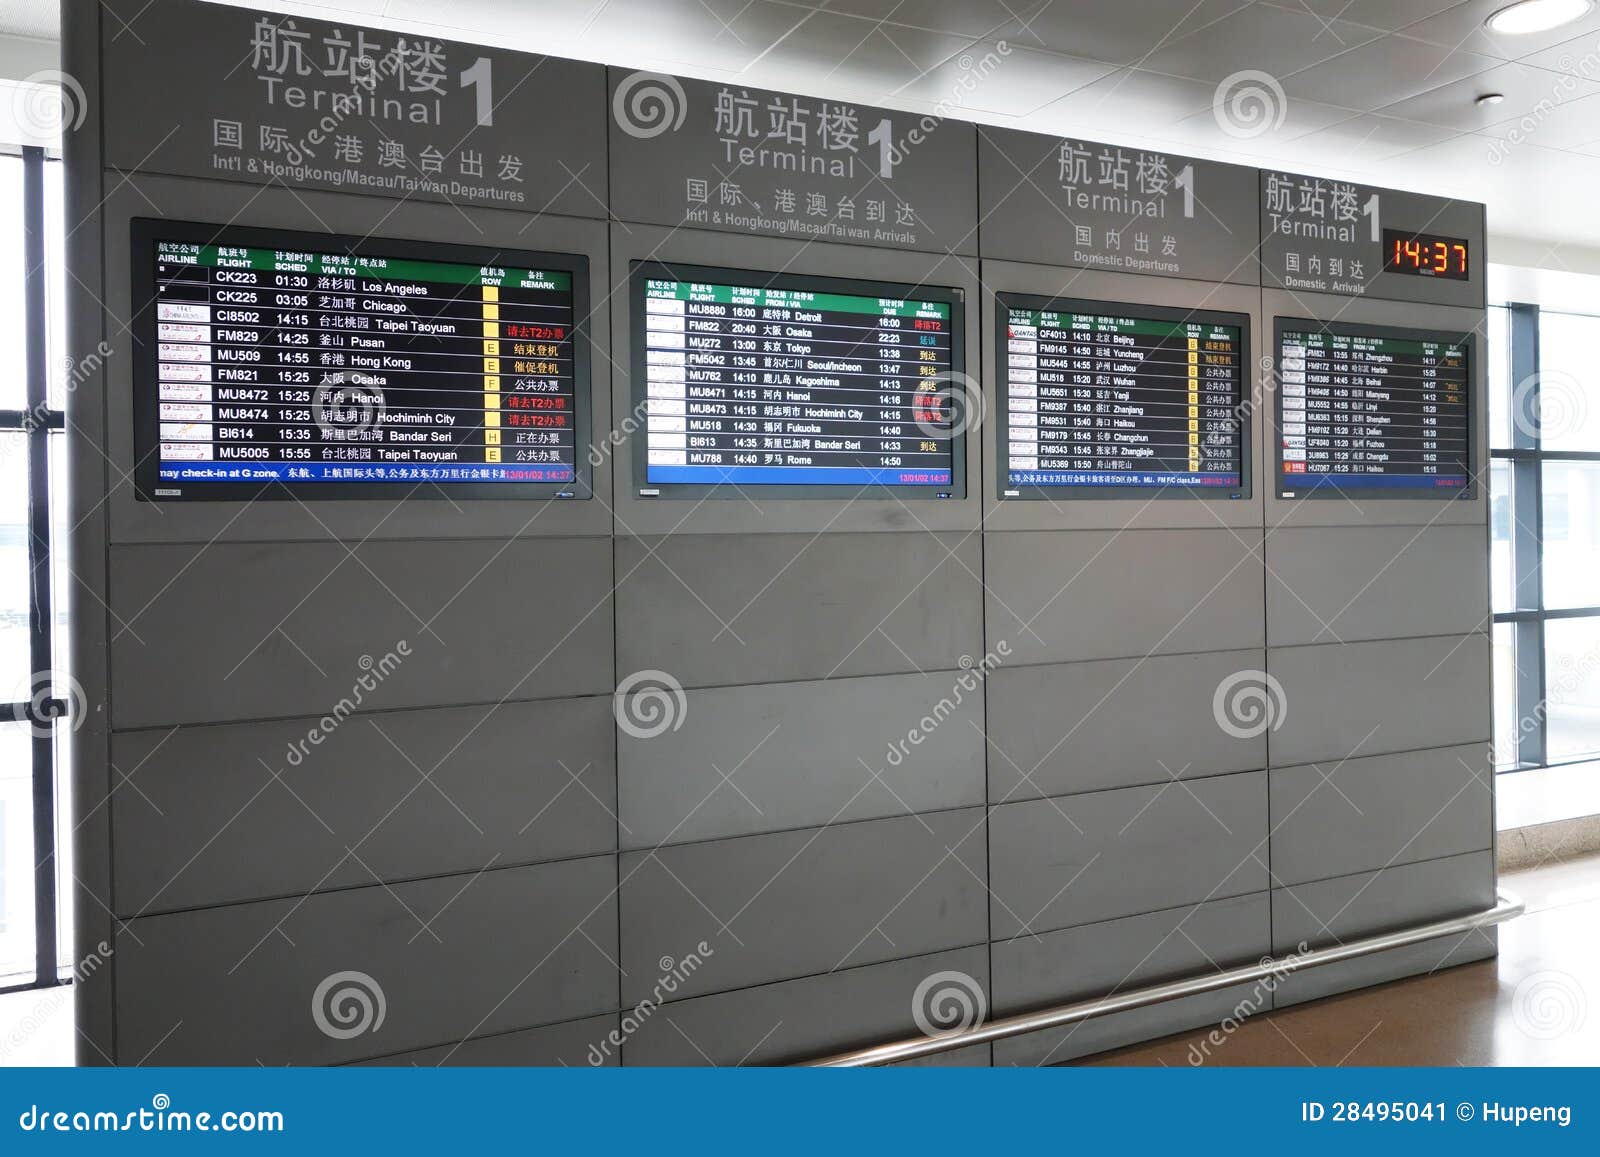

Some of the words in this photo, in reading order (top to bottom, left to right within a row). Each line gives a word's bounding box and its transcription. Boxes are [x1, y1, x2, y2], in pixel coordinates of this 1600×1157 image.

[250, 17, 447, 96] 航站楼
[460, 57, 493, 127] 1
[258, 76, 441, 126] Terminal
[714, 87, 859, 153] 航站楼
[868, 119, 893, 179] 1
[720, 138, 855, 179] Terminal
[213, 153, 241, 172] Int'l
[247, 157, 258, 173] &
[451, 182, 524, 203] Departures
[1058, 141, 1169, 197] 航站楼
[1175, 165, 1195, 218] 1
[1062, 186, 1166, 218] Terminal
[1266, 172, 1359, 223] 航站楼
[1362, 193, 1380, 242] 1
[686, 208, 708, 223] Int'l
[713, 211, 721, 224] &
[874, 228, 916, 244] Arrivals
[1270, 213, 1355, 243] Terminal
[1075, 225, 1177, 257] 国内出发
[158, 243, 199, 254] 航空公司
[218, 247, 247, 257] 航班号
[275, 252, 313, 262] 计划时间
[322, 255, 349, 265] 经停站
[360, 258, 387, 268] 终点站
[480, 267, 505, 276] 值机岛
[528, 271, 544, 279] 备注
[1073, 250, 1123, 268] Domestic
[1125, 256, 1179, 273] Departures
[1286, 252, 1364, 279] 国内到达
[1395, 240, 1466, 273] 14:37
[158, 255, 197, 264] AIRLINE
[218, 259, 252, 268] FLIGHT
[275, 263, 307, 271] SCHED
[345, 268, 356, 276] TO
[521, 281, 554, 289] REMARK
[217, 271, 257, 283] CK223
[276, 276, 307, 286] 01:30
[318, 278, 356, 291] 洛杉矶
[363, 282, 381, 291] Los
[385, 283, 427, 295] Angeles
[1285, 275, 1326, 291] Domestic
[1333, 280, 1365, 294] Arrivals
[217, 291, 257, 302] CK225
[276, 295, 308, 306] 03:05
[319, 297, 356, 310] 芝加哥
[363, 300, 406, 312] Chicago
[217, 311, 259, 322] CI8502
[277, 314, 309, 325] 14:15
[320, 316, 369, 328] 台北桃园
[376, 320, 408, 331] Taipei
[411, 322, 455, 334] Taoyuan
[733, 308, 755, 318] 16:00
[796, 313, 822, 322] Detroit
[879, 318, 900, 328] 16:00
[217, 330, 258, 341] FM829
[278, 334, 309, 344] 14:25
[320, 335, 343, 346] 釜山
[352, 337, 384, 347] Pusan
[690, 322, 719, 332] FM822
[732, 324, 756, 334] 20:40
[763, 326, 781, 336] 大阪
[786, 328, 812, 337] Osaka
[879, 334, 900, 343] 22:23
[690, 338, 720, 348] MU272
[733, 341, 756, 350] 13:00
[763, 342, 781, 352] 东京
[787, 344, 811, 354] Tokyo
[218, 350, 260, 361] MU509
[278, 353, 309, 363] 14:55
[320, 353, 344, 365] 香港
[352, 356, 381, 368] Hong
[384, 357, 411, 369] Kong
[218, 369, 258, 381] FM821
[279, 372, 310, 382] 15:25
[321, 372, 344, 384] 大阪
[352, 375, 386, 385] Osaka
[515, 380, 559, 391] 公共办票
[796, 376, 839, 387] Kagoshima
[219, 389, 268, 400] MU8472
[279, 391, 310, 402] 15:25
[320, 391, 344, 403] 河内
[352, 393, 383, 403] Hanoi
[219, 409, 268, 420] MU8474
[279, 411, 310, 420] 15:25
[321, 410, 370, 422] 胡志明市
[378, 413, 432, 423] Hochiminh
[436, 414, 455, 426] City
[690, 404, 726, 414] MU8473
[734, 406, 756, 415] 14:15
[806, 409, 846, 418] Hochiminh
[848, 411, 863, 420] City
[220, 428, 253, 439] BI614
[280, 429, 310, 439] 15:35
[391, 431, 427, 441] Bandar
[431, 432, 451, 441] Seri
[517, 433, 559, 444] 正在办票
[691, 421, 721, 430] MU518
[734, 422, 757, 431] 14:30
[787, 424, 821, 433] Fukuoka
[220, 448, 269, 458] MU5005
[280, 449, 310, 458] 15:55
[322, 447, 370, 459] 台北桃园
[378, 450, 410, 461] Taipei
[414, 451, 457, 462] Taoyuan
[517, 451, 559, 461] 公共办票
[691, 454, 722, 463] MU788
[735, 455, 757, 463] 14:40
[788, 456, 811, 464] Rome
[881, 457, 901, 466] 14:50
[182, 468, 227, 478] check-in
[230, 469, 240, 477] at
[242, 469, 250, 477] G
